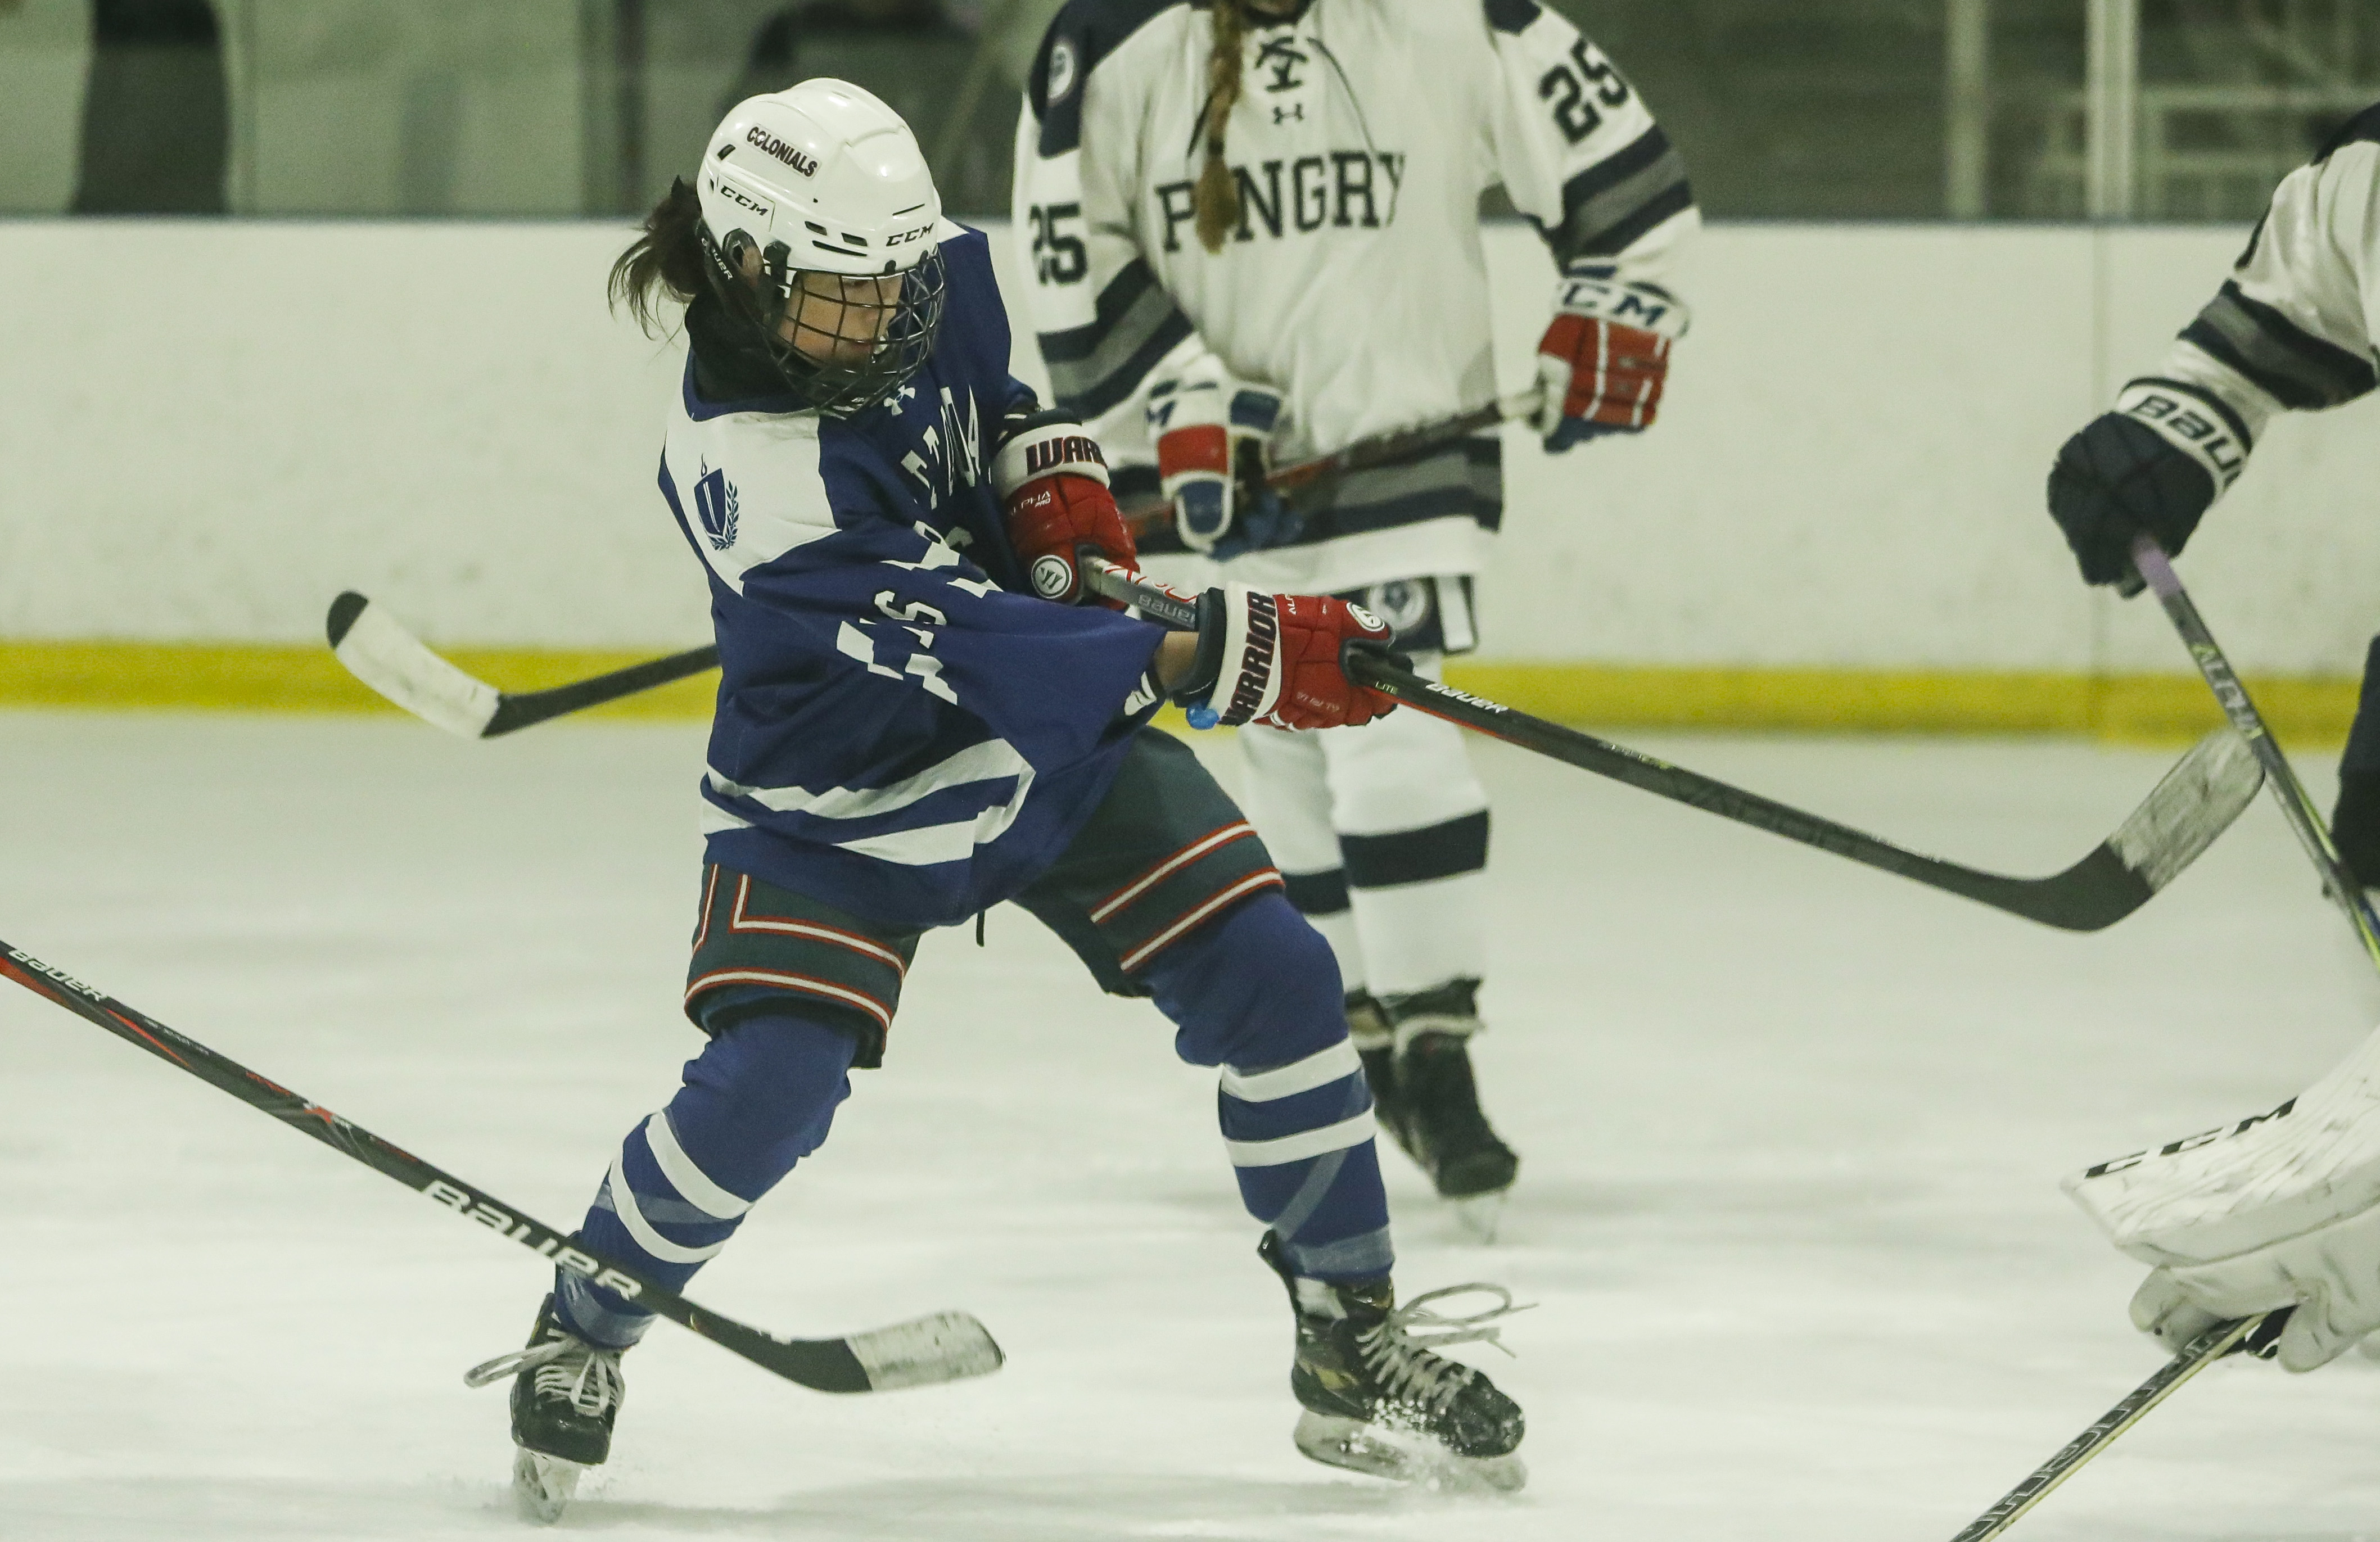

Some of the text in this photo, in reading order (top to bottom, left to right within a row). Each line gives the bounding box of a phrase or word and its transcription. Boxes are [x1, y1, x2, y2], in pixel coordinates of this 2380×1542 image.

[1539, 37, 1629, 144] 25
[747, 126, 818, 177] COLONIALS
[720, 185, 768, 216] CCM
[1155, 150, 1406, 252] PNGRY
[886, 223, 934, 247] CCM
[1557, 282, 1667, 327] CM
[2084, 1095, 2299, 1180] CCM
[422, 1179, 642, 1300] BAUER
